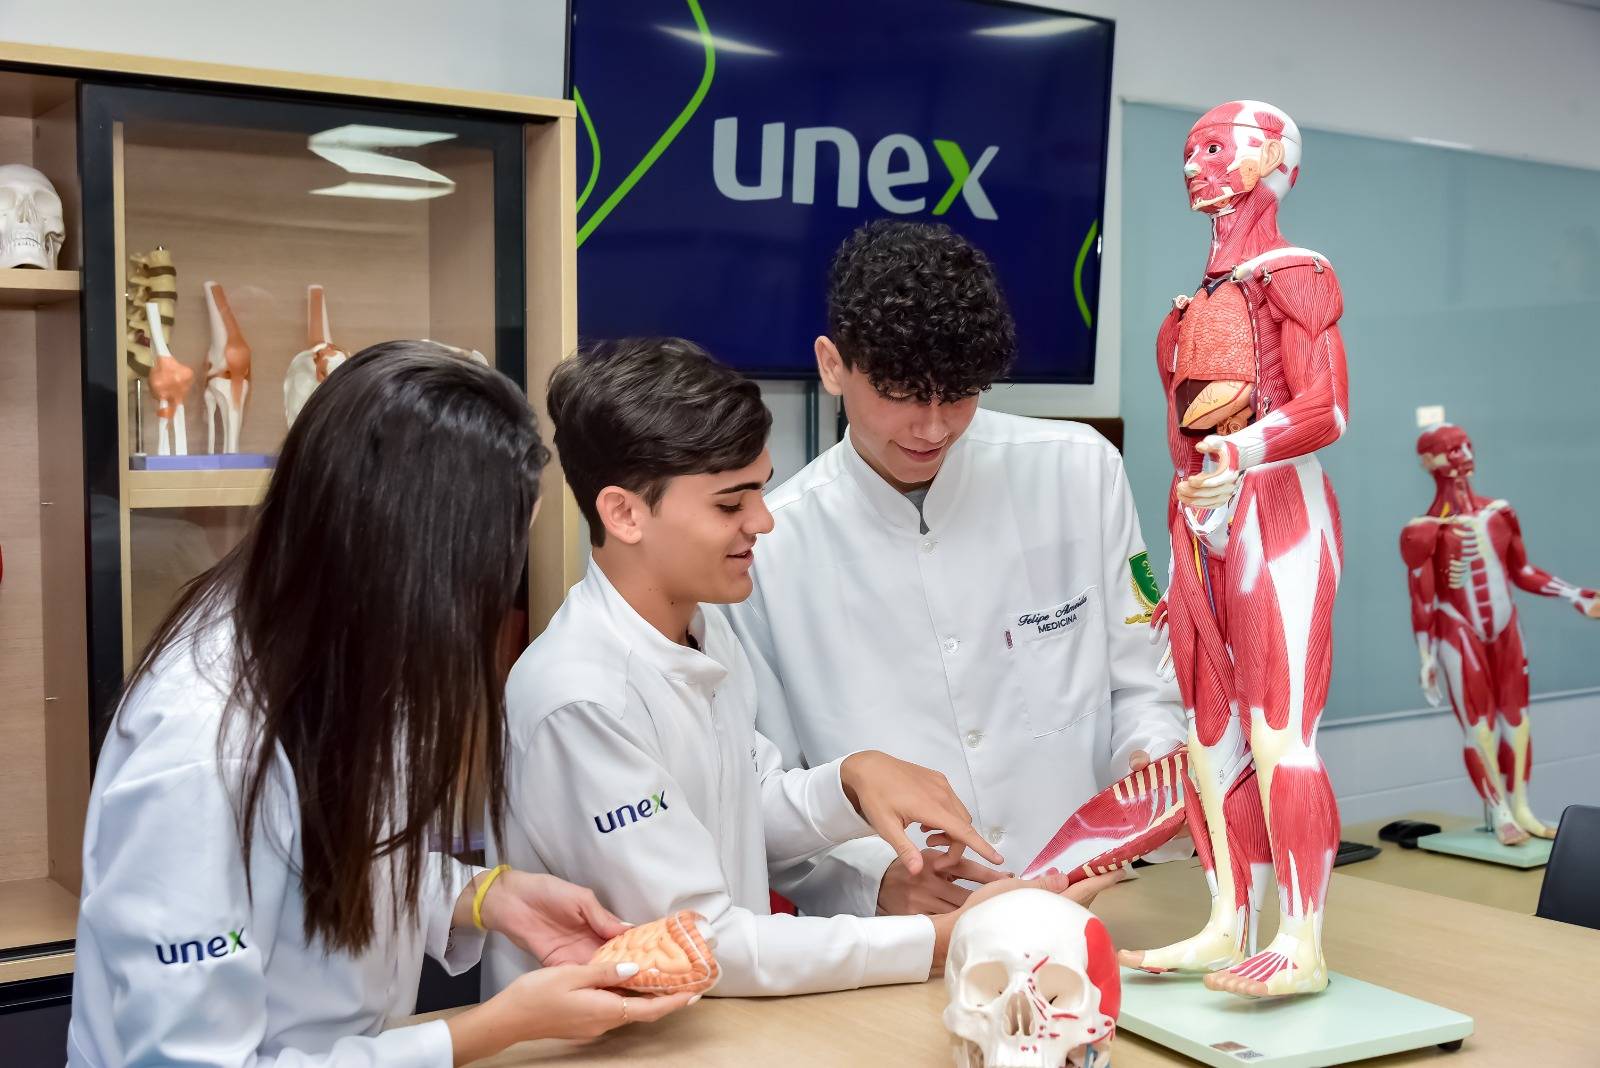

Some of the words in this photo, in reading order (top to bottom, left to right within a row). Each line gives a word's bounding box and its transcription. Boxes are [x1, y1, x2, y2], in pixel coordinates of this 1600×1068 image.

[712, 116, 1000, 221] unex
[1018, 613, 1050, 627] Felipe
[1037, 613, 1078, 634] MEDICINA
[594, 790, 668, 834] unex
[155, 927, 247, 965] unex
